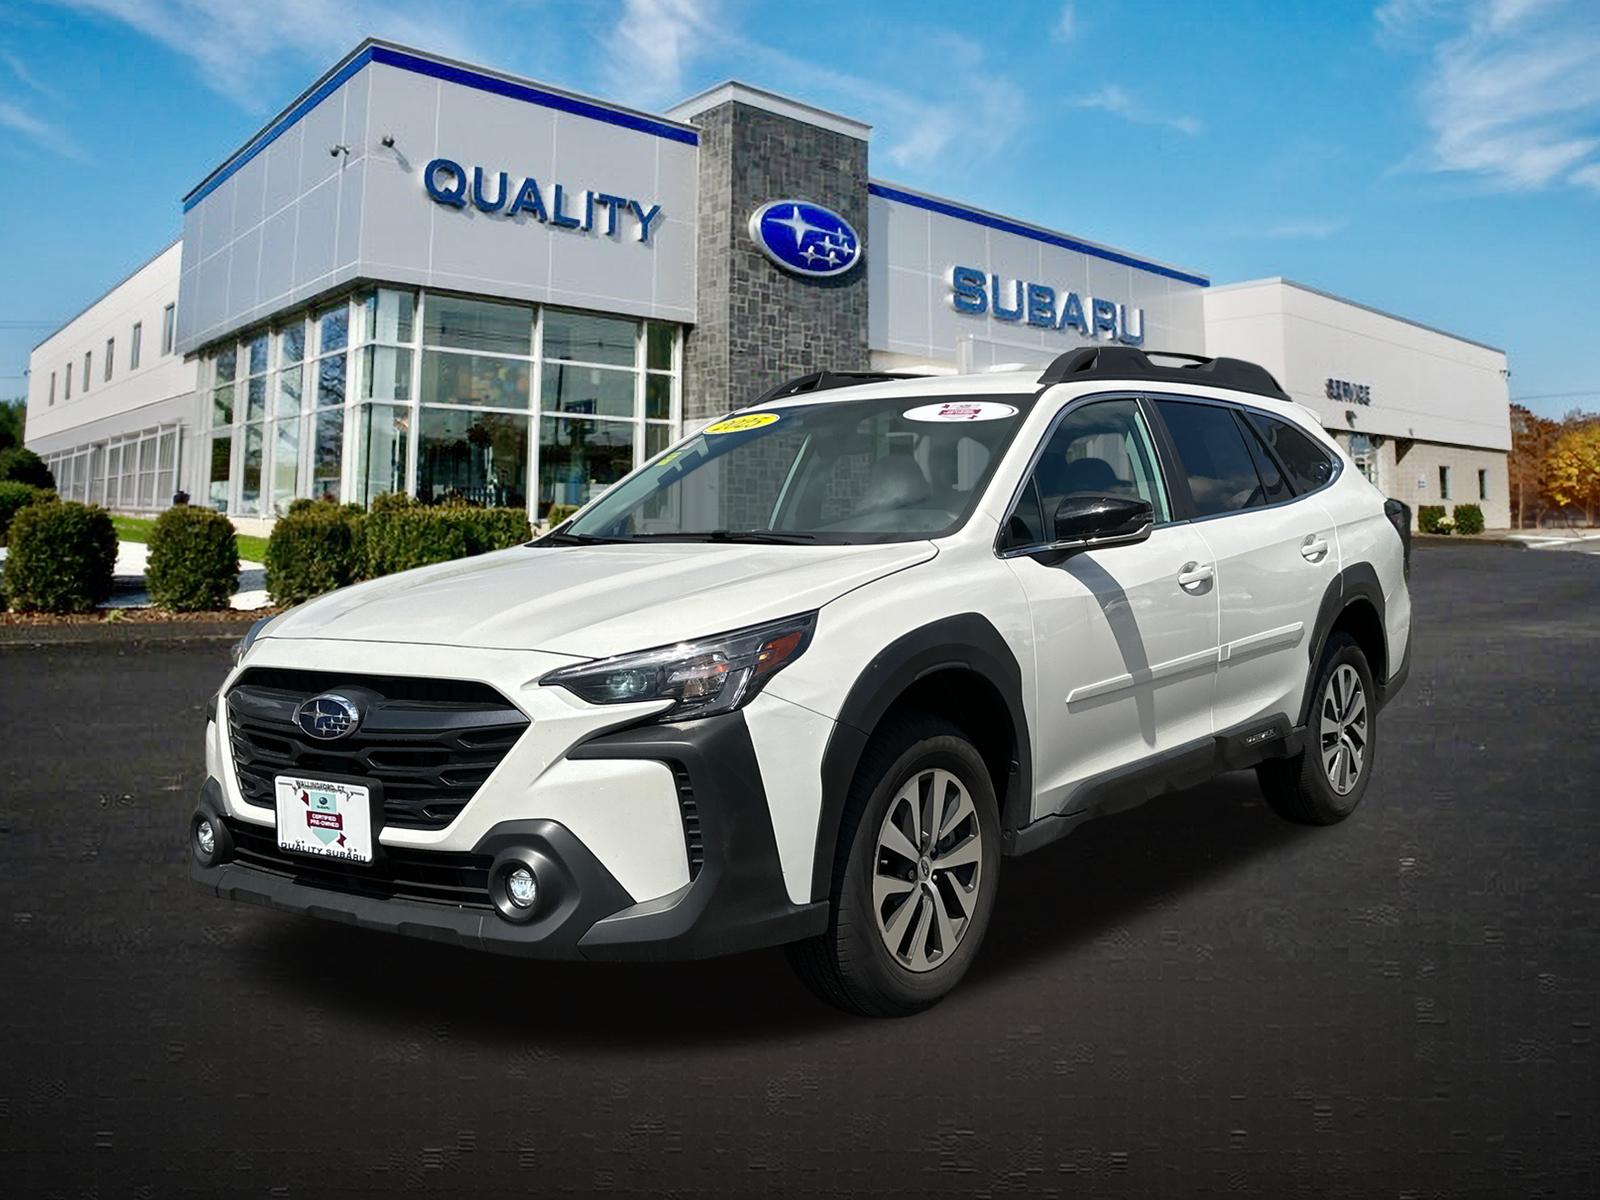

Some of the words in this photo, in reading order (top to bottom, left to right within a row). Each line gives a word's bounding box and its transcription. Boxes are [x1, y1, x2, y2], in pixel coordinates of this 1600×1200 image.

[424, 158, 661, 242] QUALITY
[951, 265, 1145, 346] SUBARU
[1324, 378, 1370, 406] SERVICE
[309, 819, 340, 828] PRE-OWNED
[311, 813, 337, 822] CERTIFIED
[280, 841, 323, 855] QUALITY
[325, 849, 367, 861] SUBARU
